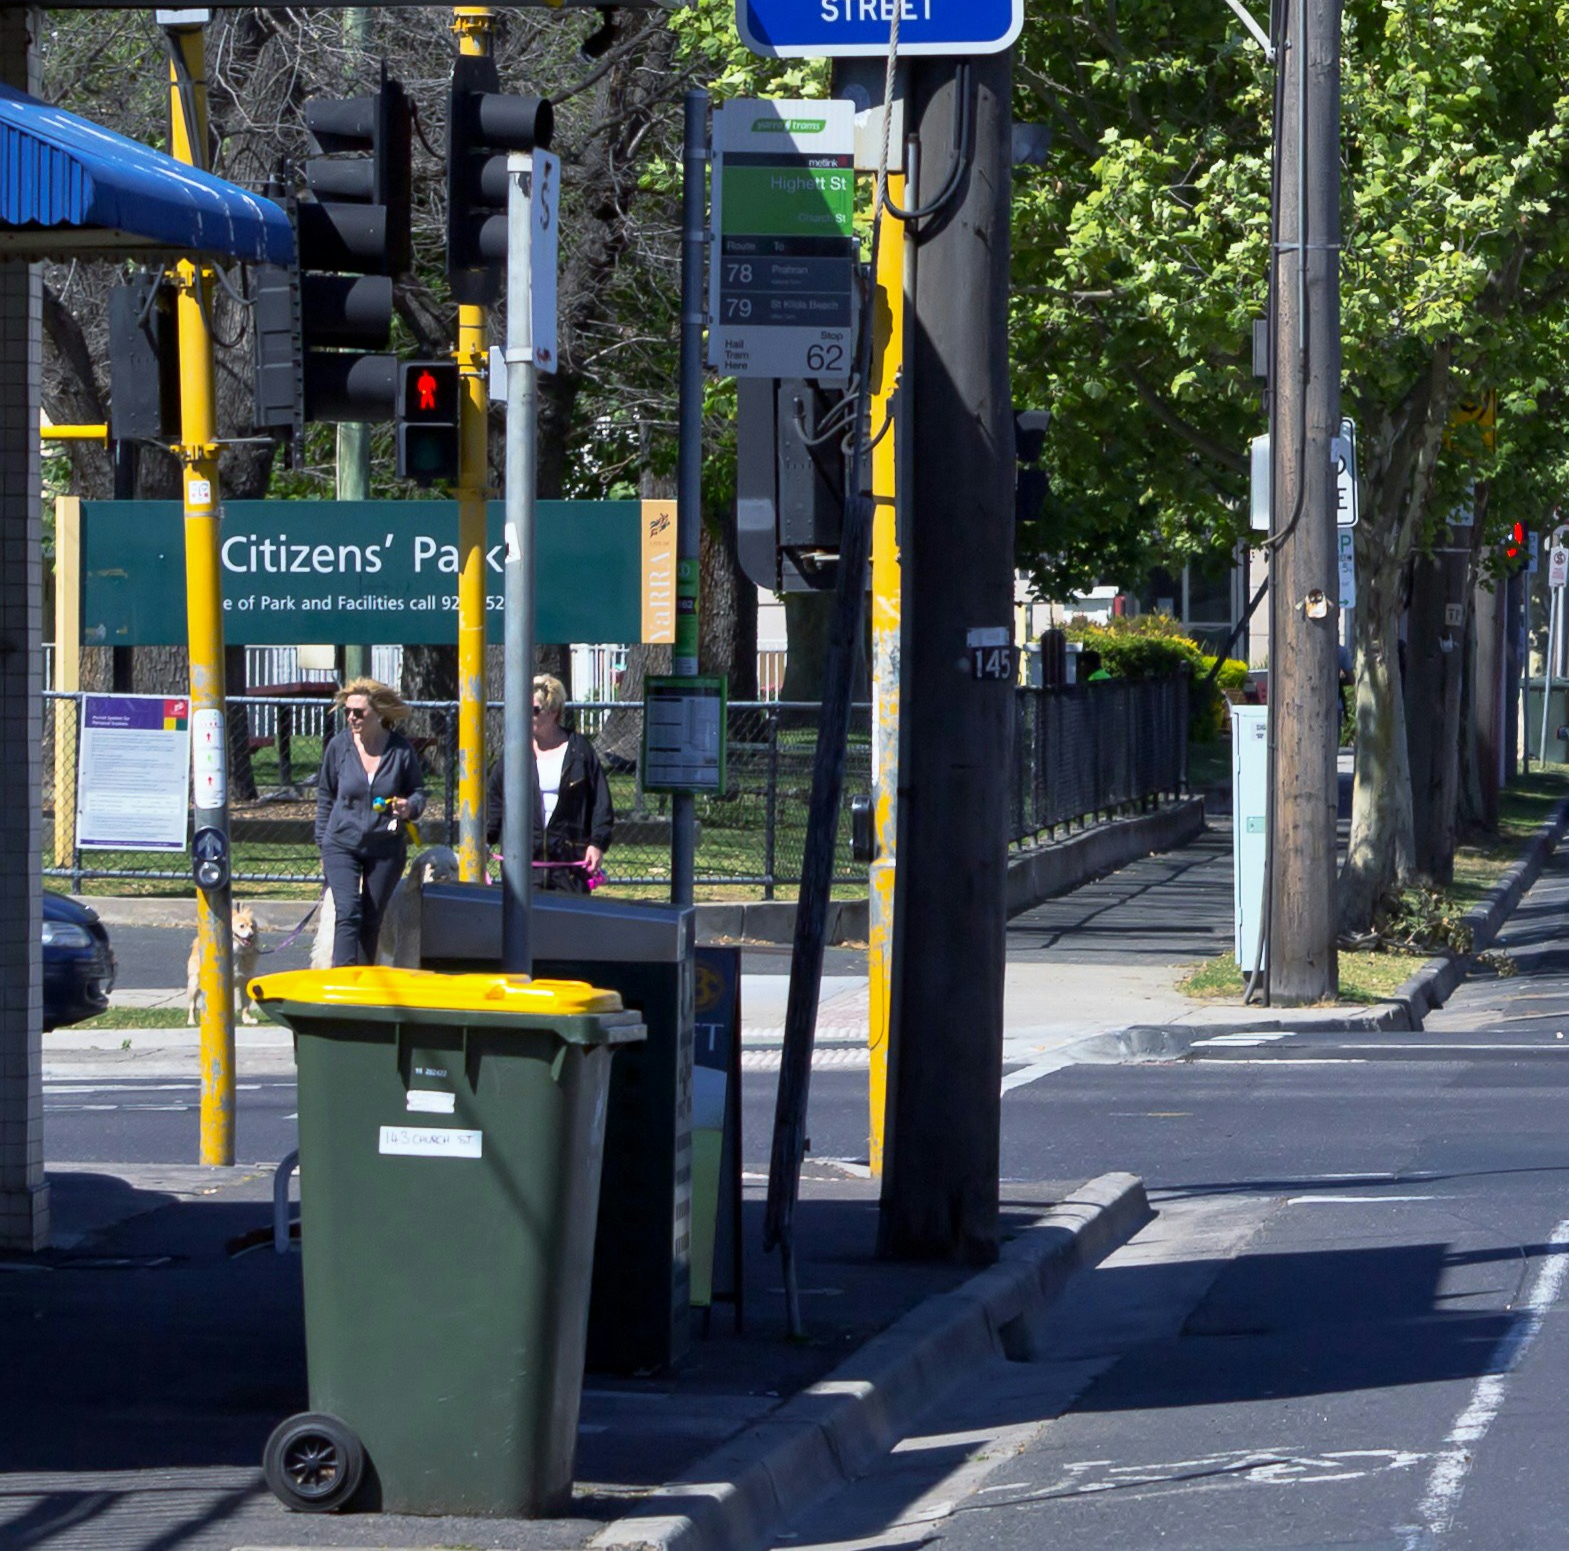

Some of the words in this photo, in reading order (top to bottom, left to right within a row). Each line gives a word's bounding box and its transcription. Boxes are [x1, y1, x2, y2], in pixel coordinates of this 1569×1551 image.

[771, 176, 825, 193] Highett
[830, 177, 847, 190] St
[835, 213, 846, 223] St
[774, 241, 785, 251] To
[727, 264, 753, 283] 78
[726, 298, 752, 317] 79
[821, 330, 844, 340] Stop
[807, 344, 844, 371] 62
[221, 533, 394, 573] Citizens'
[414, 534, 504, 573] Pak
[238, 594, 255, 610] of
[261, 596, 296, 610] Park
[301, 594, 333, 610] and
[338, 594, 404, 610] Facilities
[410, 594, 437, 610] call
[976, 649, 1010, 679] 145
